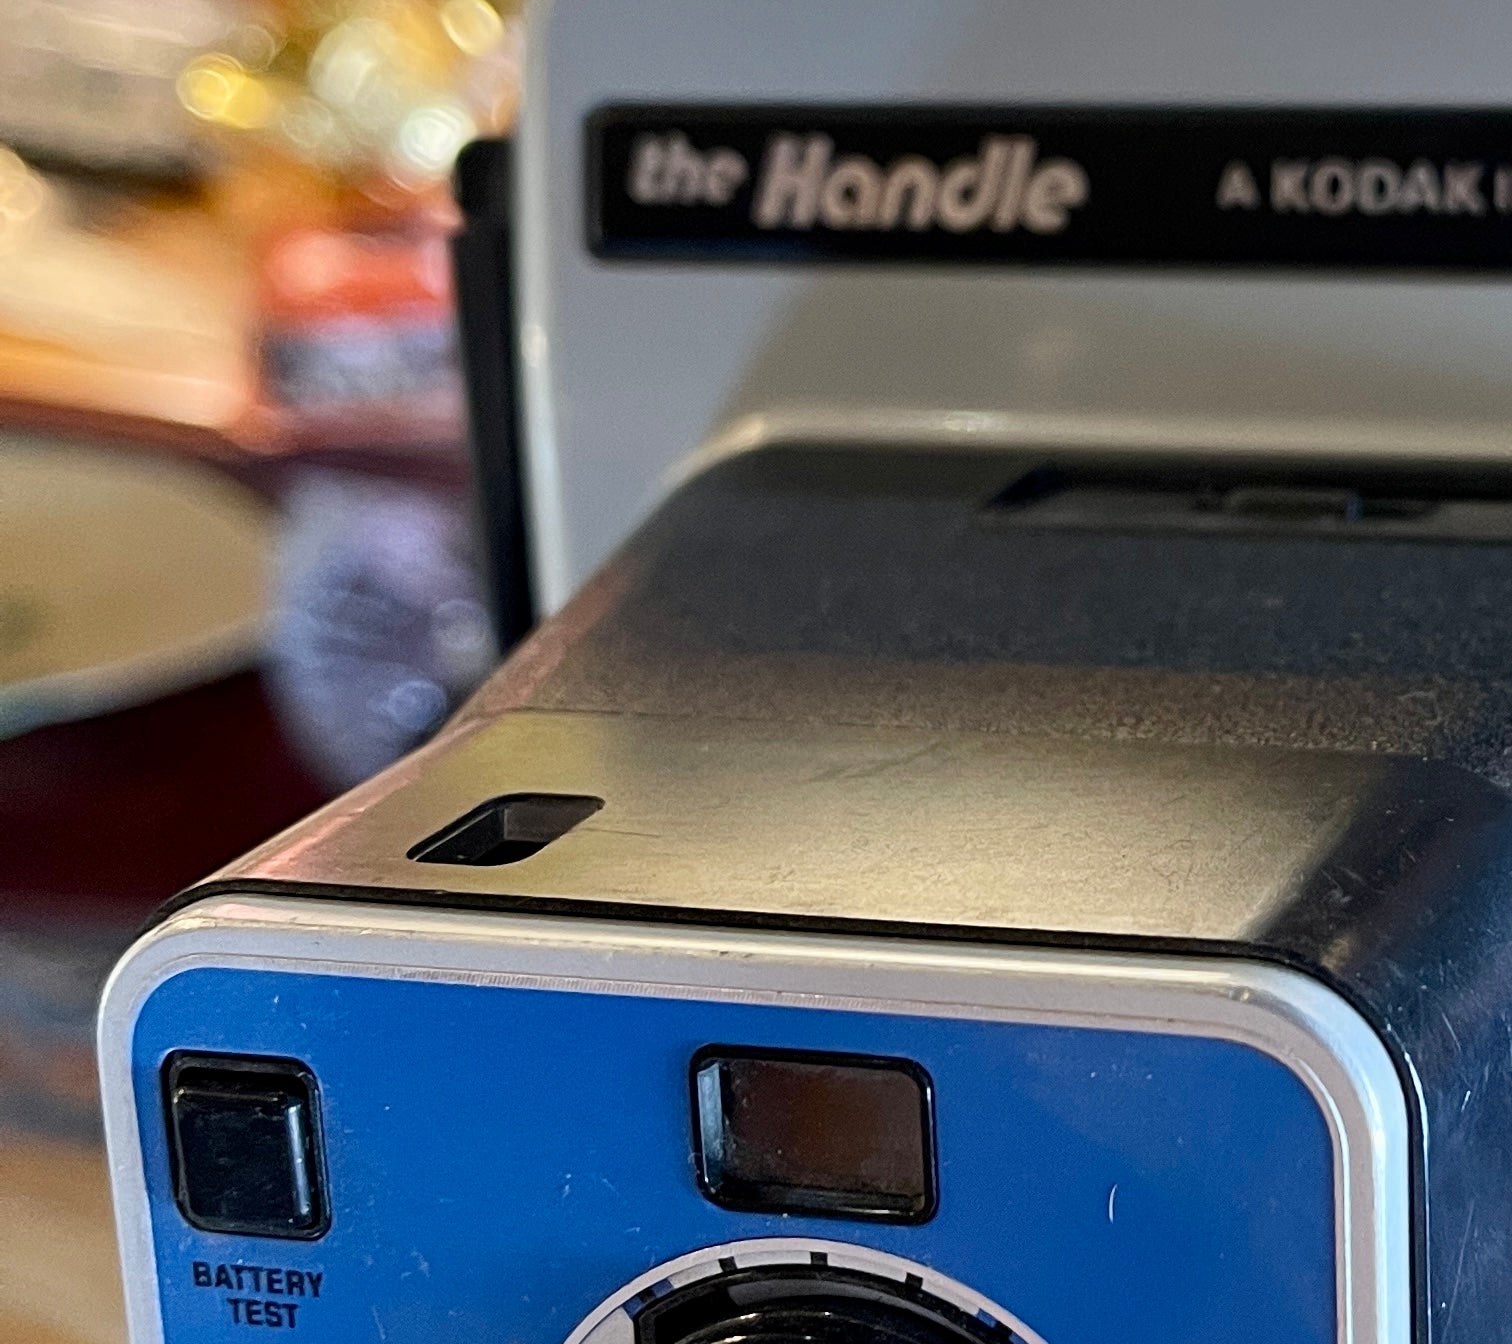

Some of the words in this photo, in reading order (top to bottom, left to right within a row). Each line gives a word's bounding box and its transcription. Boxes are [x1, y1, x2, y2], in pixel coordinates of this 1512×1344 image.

[628, 134, 748, 205] the
[752, 134, 1089, 233] Handle
[1216, 159, 1259, 209] A
[1270, 159, 1485, 215] KODAK
[192, 1261, 323, 1297] BATTERY
[227, 1298, 299, 1328] TEST
